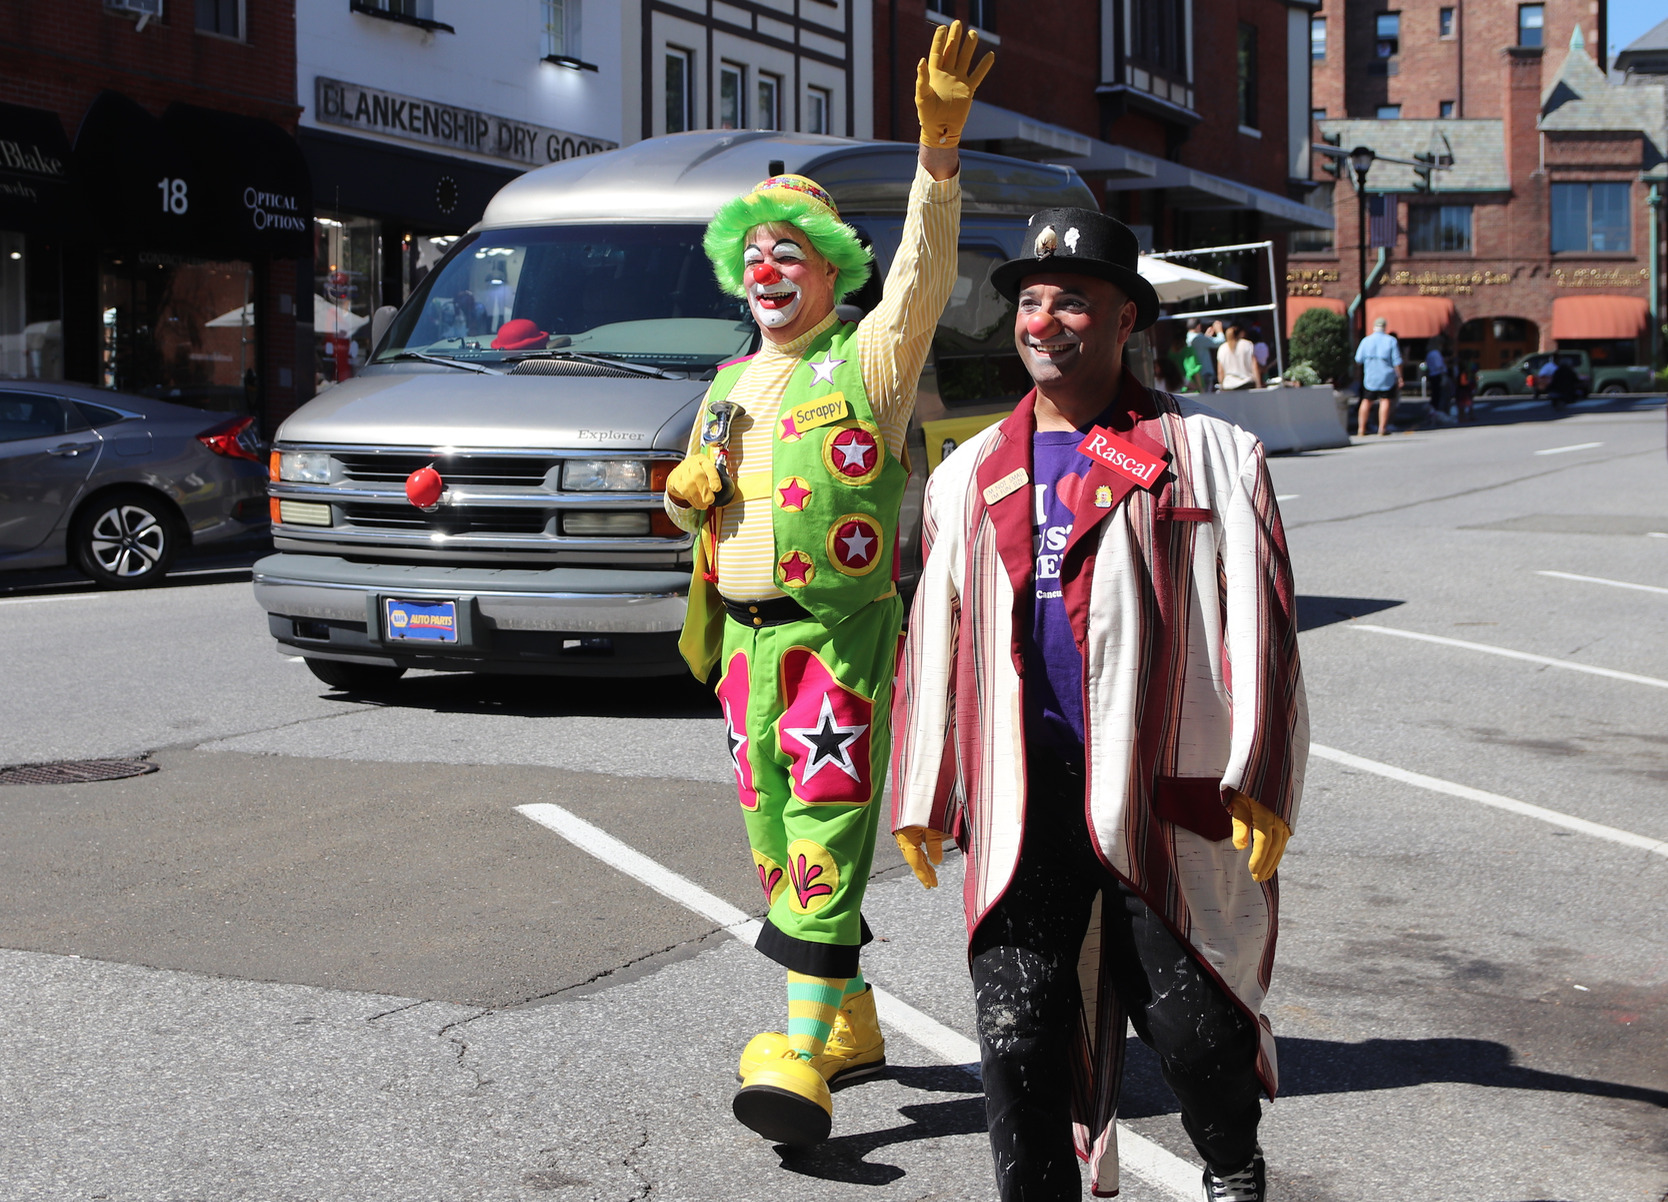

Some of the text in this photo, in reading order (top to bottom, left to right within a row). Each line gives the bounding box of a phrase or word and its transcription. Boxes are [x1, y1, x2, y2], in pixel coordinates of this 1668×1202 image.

[323, 84, 617, 162] BLANKENSHIP DRY GOO
[0, 140, 65, 176] Blake
[158, 177, 188, 215] 18
[244, 186, 298, 211] OPTICAL
[253, 208, 306, 232] OPTIONS
[796, 400, 842, 424] Scrappy
[578, 429, 645, 442] Explorer
[1086, 433, 1157, 481] Rascal
[1033, 484, 1048, 525] I
[1036, 590, 1063, 600] Cancu
[410, 614, 430, 624] AUTO
[430, 615, 453, 626] PARTS
